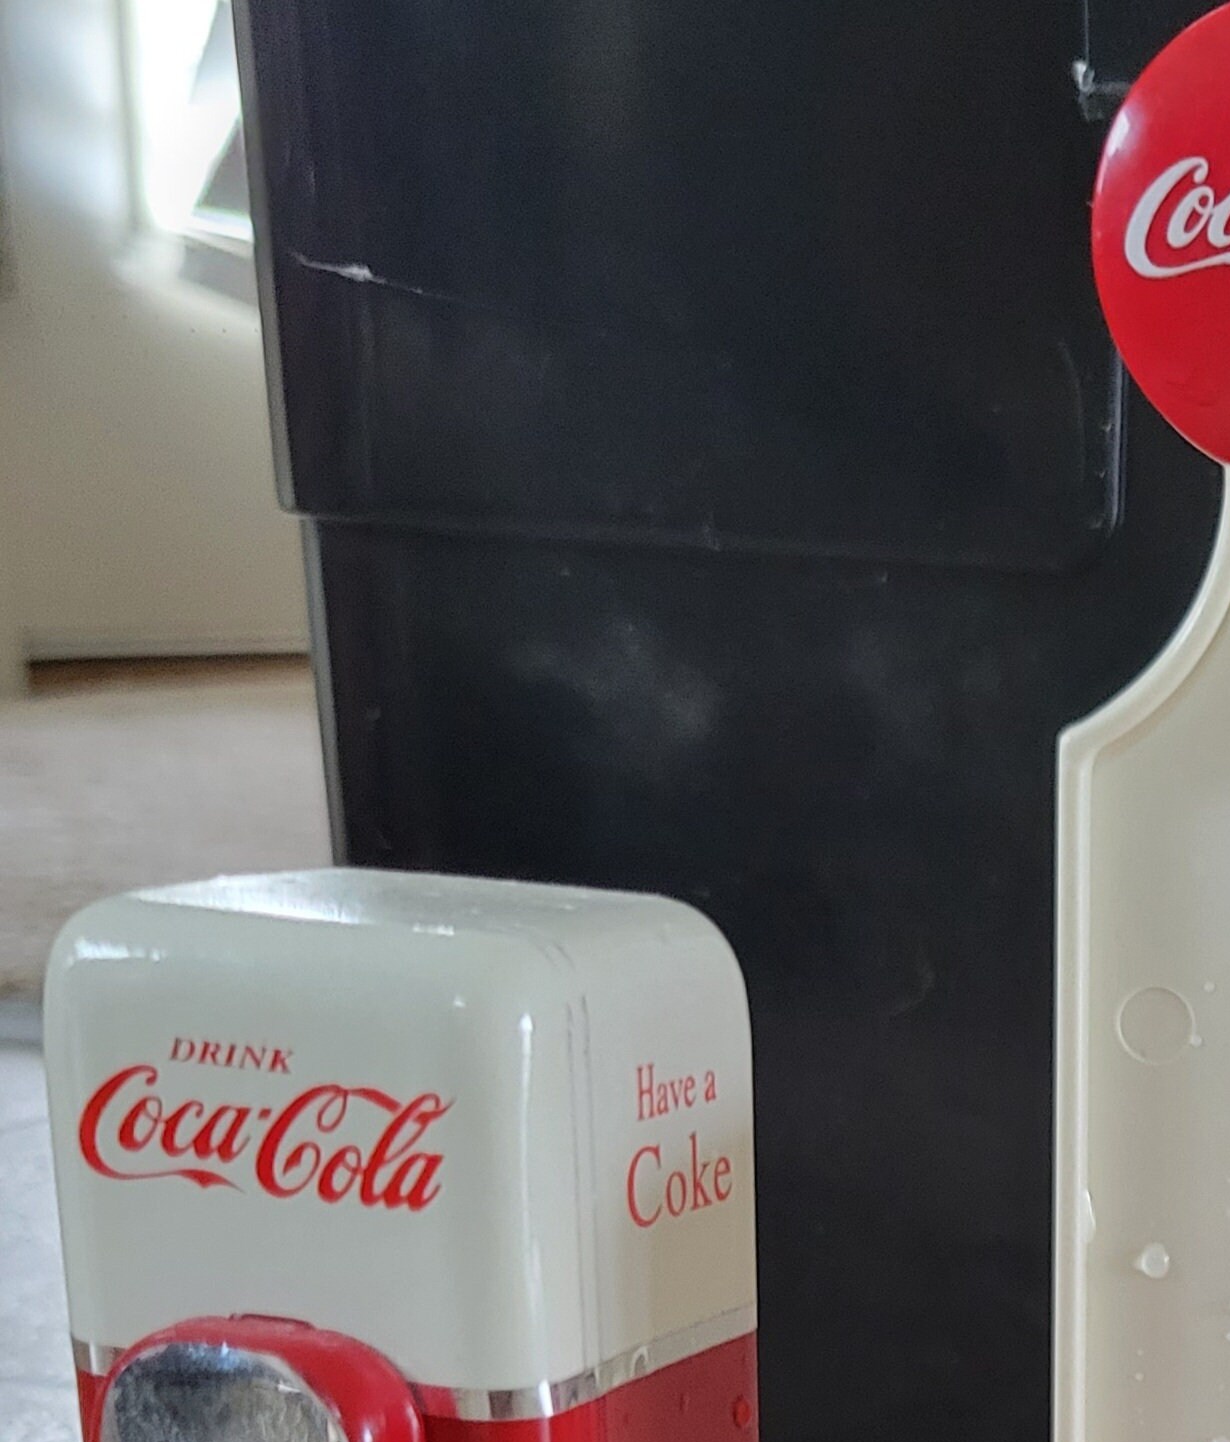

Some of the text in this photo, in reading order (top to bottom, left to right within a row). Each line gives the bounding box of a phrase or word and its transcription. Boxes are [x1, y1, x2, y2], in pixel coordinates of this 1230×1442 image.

[169, 1036, 297, 1075] DRINK
[636, 1062, 717, 1121] Have a
[78, 1064, 457, 1213] Coca-Cola
[627, 1131, 733, 1229] Coke
